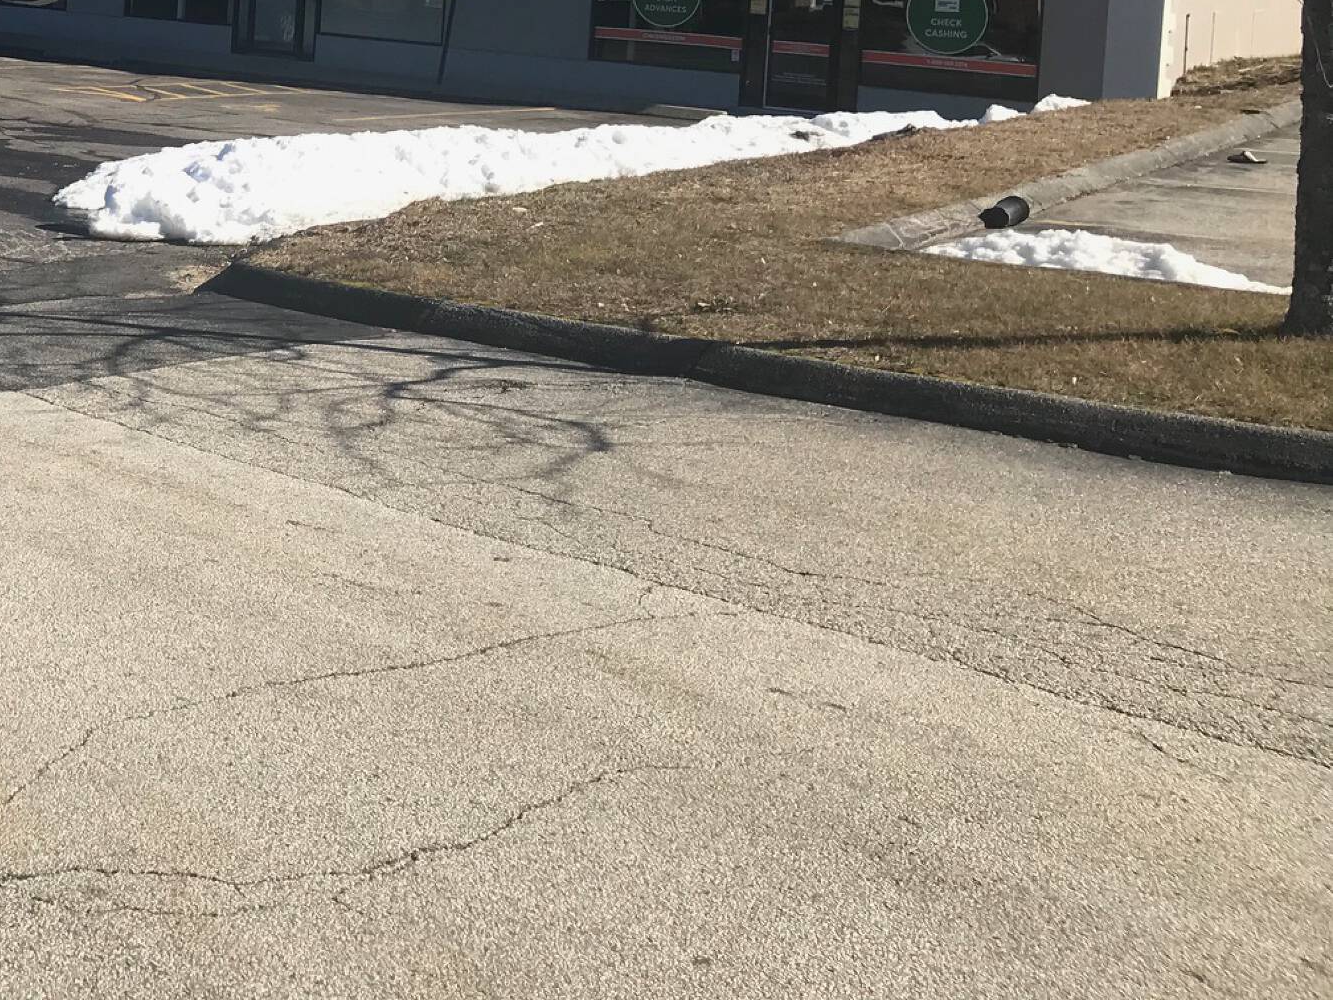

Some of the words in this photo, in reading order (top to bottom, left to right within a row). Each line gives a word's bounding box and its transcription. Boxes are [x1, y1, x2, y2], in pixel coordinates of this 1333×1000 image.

[645, 3, 687, 14] ADVANCES
[930, 17, 962, 28] CHECK
[924, 28, 968, 40] CASHING
